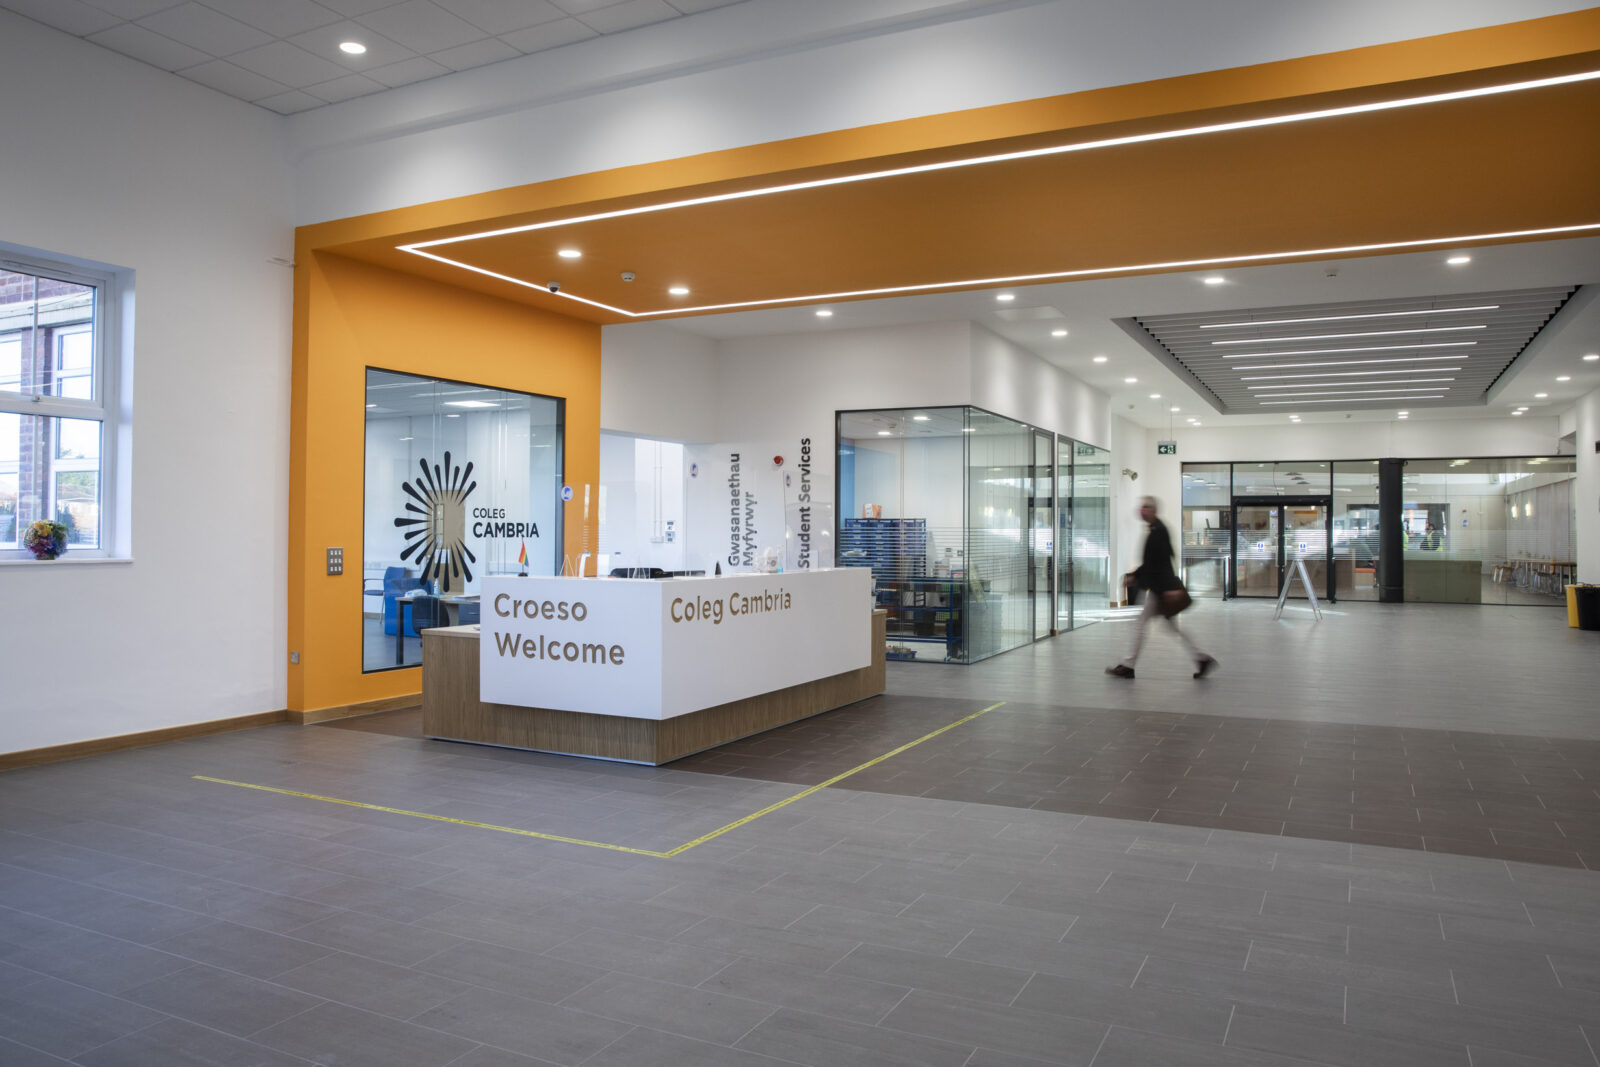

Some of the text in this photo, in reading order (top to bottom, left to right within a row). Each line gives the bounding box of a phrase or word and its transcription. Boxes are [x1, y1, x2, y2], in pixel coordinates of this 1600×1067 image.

[472, 507, 506, 519] COLEG
[728, 453, 740, 567] Gwasanaethau
[798, 438, 811, 569] Student Services
[472, 521, 540, 538] CAMBRIA
[743, 491, 757, 567] Myfyrwyr
[494, 592, 588, 621] Croeso
[671, 587, 792, 625] Coleg Cambria
[494, 631, 625, 665] Welcome
